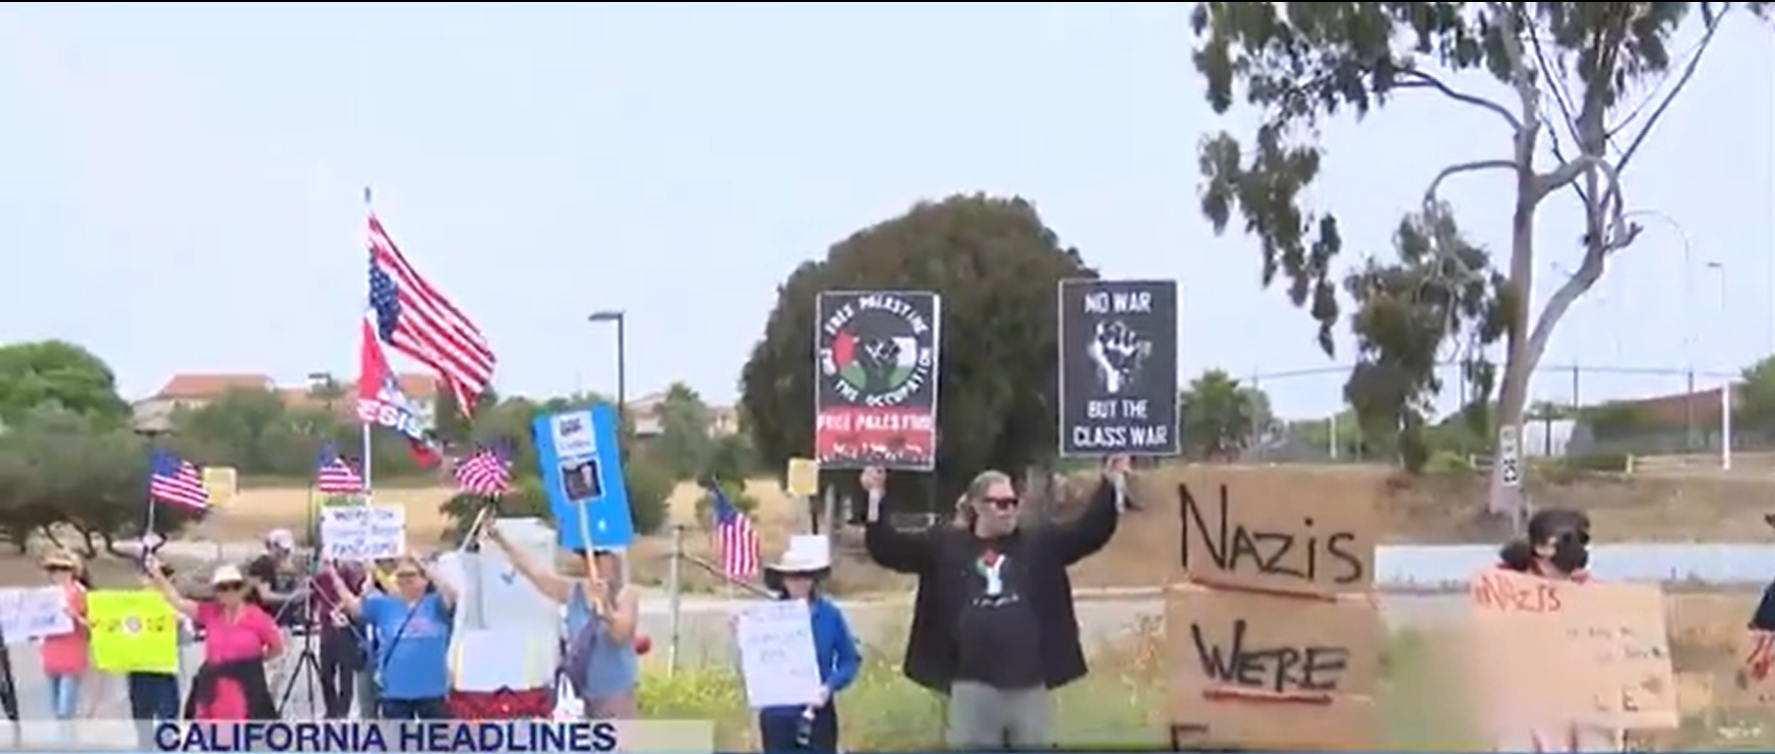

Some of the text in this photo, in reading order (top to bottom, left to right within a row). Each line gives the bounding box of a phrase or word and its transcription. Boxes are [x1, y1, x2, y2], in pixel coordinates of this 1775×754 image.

[1085, 292, 1151, 313] NO WAR
[1088, 400, 1149, 419] BUT THE
[1073, 426, 1168, 447] CLASS WAR
[1190, 619, 1348, 693] WERE
